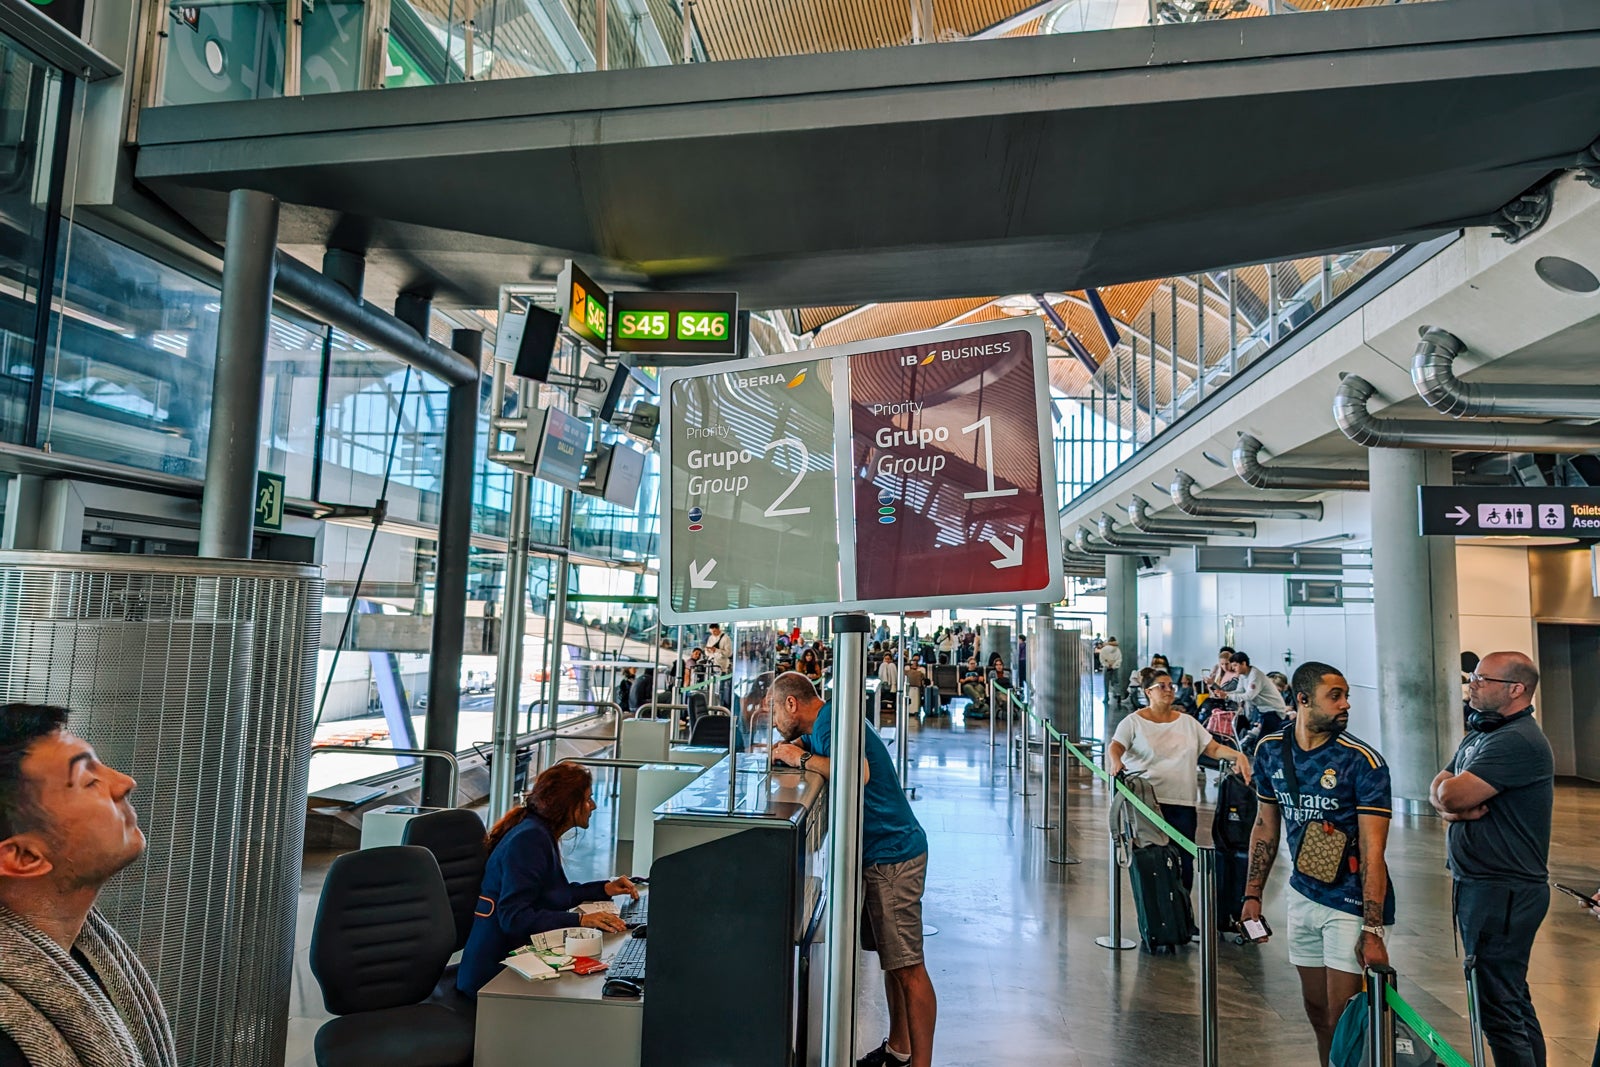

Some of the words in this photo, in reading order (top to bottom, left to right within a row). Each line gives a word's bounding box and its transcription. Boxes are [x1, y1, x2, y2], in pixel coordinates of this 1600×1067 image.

[588, 301, 605, 334] S45
[622, 314, 665, 335] S45
[681, 315, 725, 336] S46
[900, 354, 918, 367] IB
[941, 341, 1011, 361] BUSINESS
[733, 373, 786, 389] IBERIA
[873, 399, 923, 417] Priority
[686, 423, 731, 440] Priority
[875, 426, 949, 450] Grupo
[687, 448, 752, 471] Grupo
[877, 454, 946, 477] Group
[961, 415, 1019, 500] 1
[688, 475, 749, 497] Group
[763, 437, 811, 518] 2
